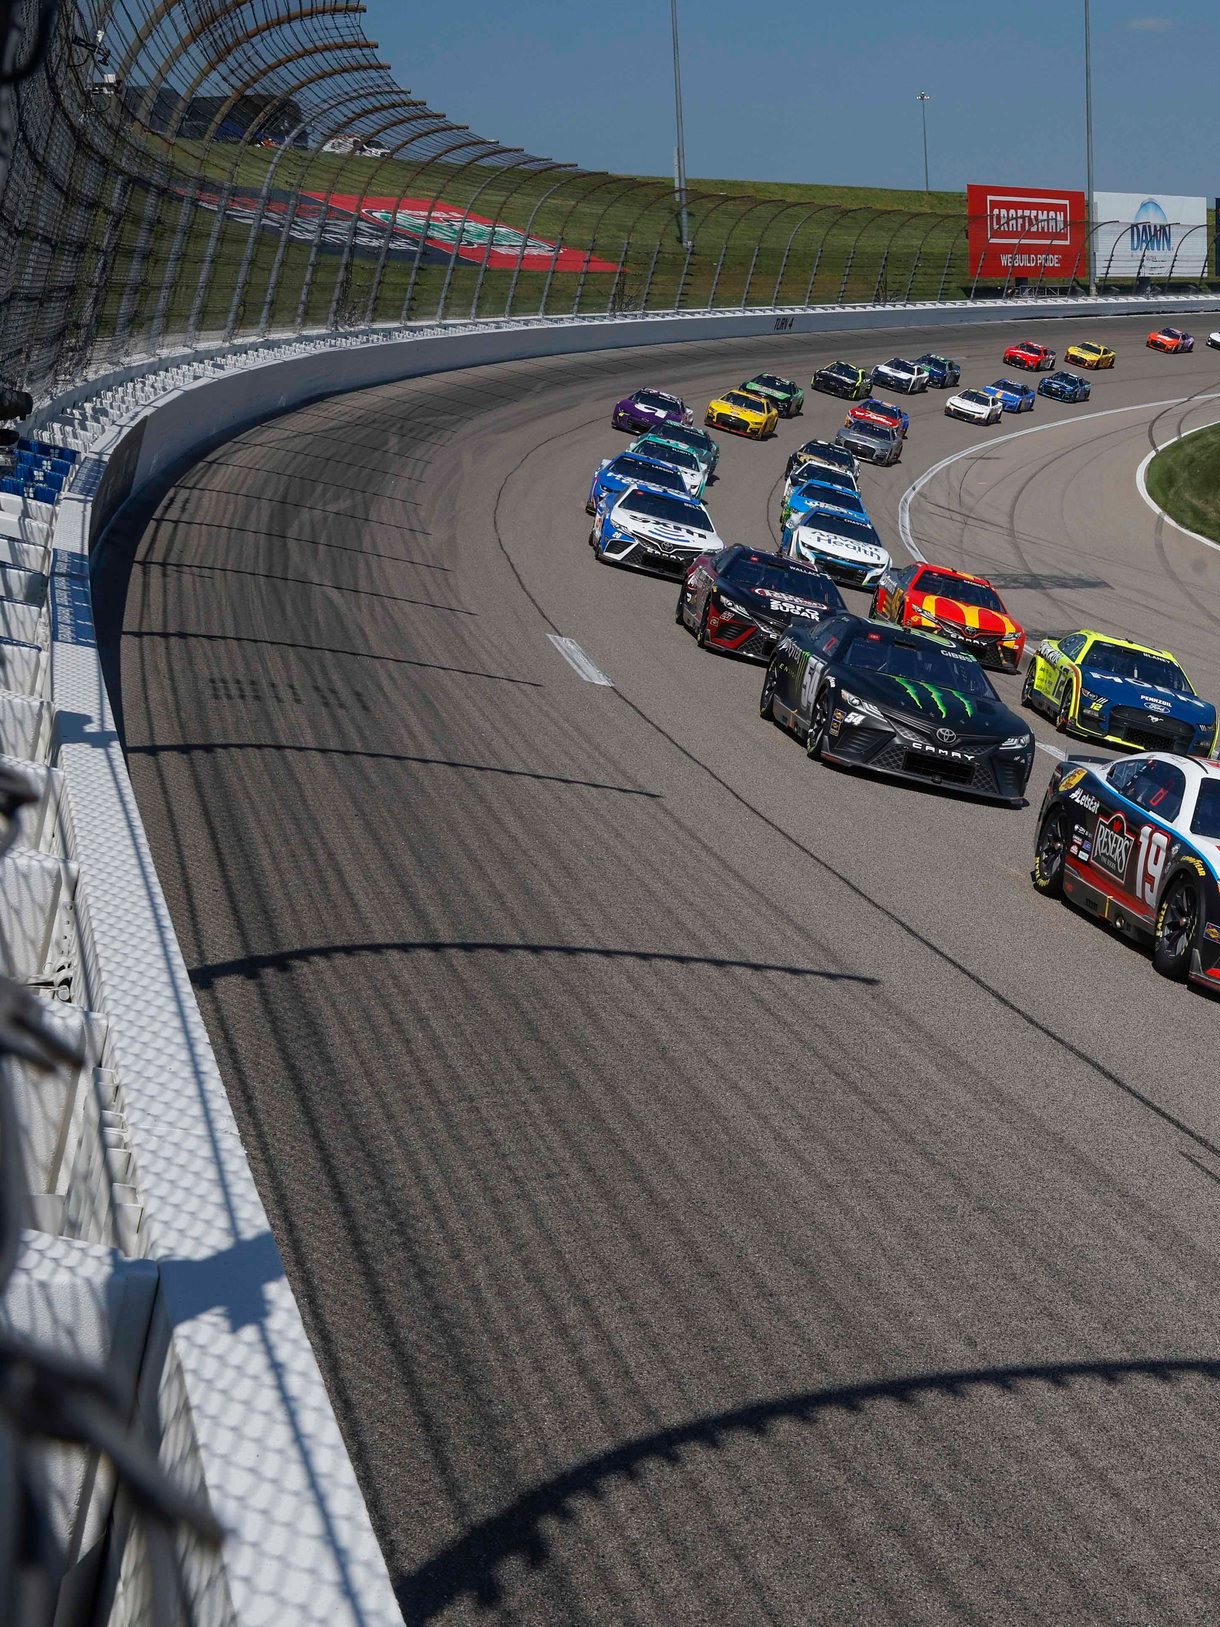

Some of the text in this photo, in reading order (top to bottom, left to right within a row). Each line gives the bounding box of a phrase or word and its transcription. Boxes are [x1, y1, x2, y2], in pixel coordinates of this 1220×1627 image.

[993, 209, 1064, 233] CRAFTSMAN
[1130, 224, 1172, 251] DAWN
[1000, 254, 1012, 266] WE
[1013, 254, 1036, 267] BUILD
[817, 536, 881, 561] Health
[789, 566, 820, 577] WALLACE
[941, 650, 976, 663] GIBBS
[1090, 702, 1103, 711] 12
[1141, 695, 1172, 708] PENNZOIL
[845, 712, 866, 726] 54
[912, 742, 976, 760] CAMRY
[1094, 824, 1130, 873] RESER'S
[1135, 824, 1169, 909] 19
